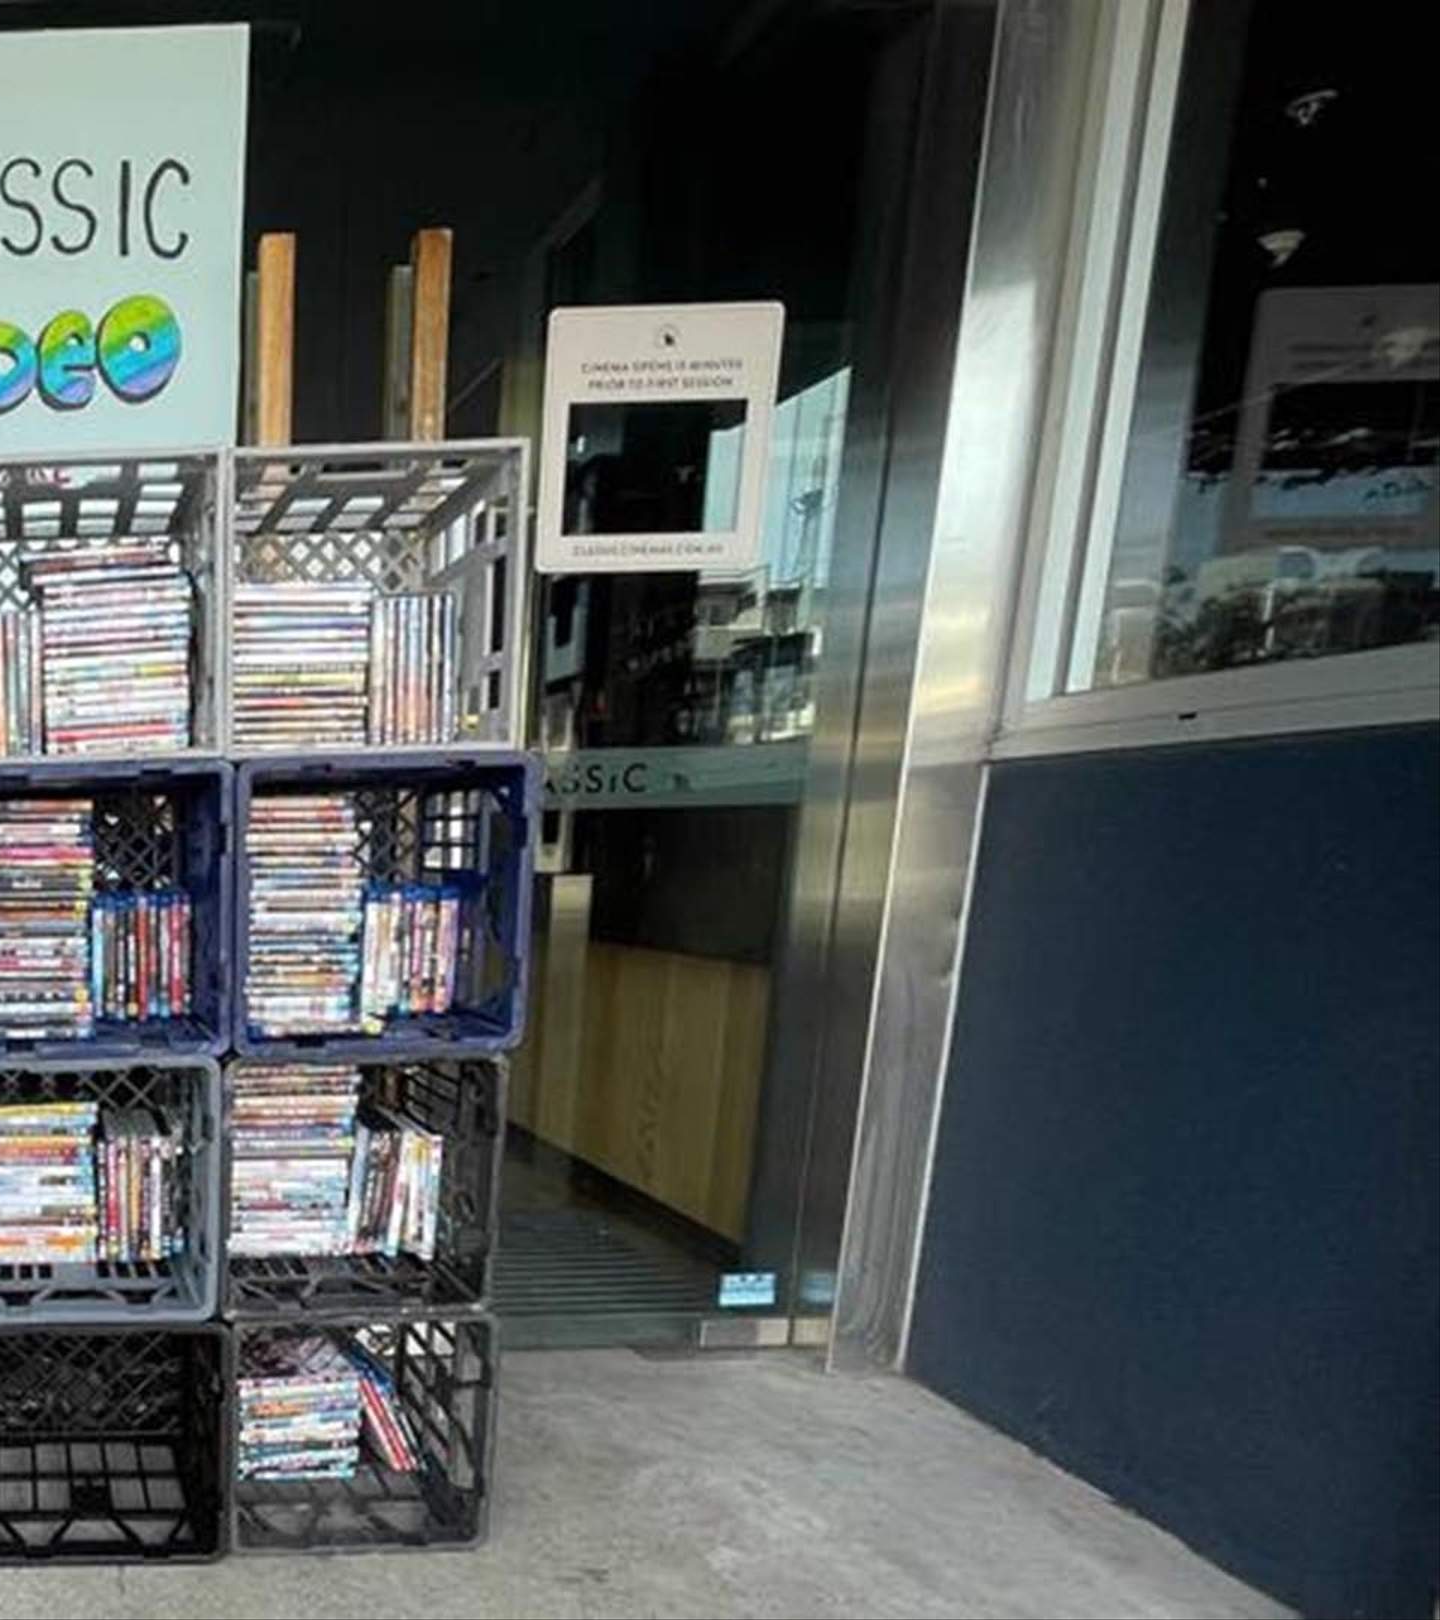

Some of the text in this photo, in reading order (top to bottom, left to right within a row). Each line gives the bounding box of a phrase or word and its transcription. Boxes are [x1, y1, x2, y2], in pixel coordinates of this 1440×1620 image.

[581, 361, 629, 374] CINEMA
[632, 360, 672, 373] OPENS
[689, 358, 743, 371] MINUTES
[588, 375, 733, 390] PRIOR TO FIRST SESSION
